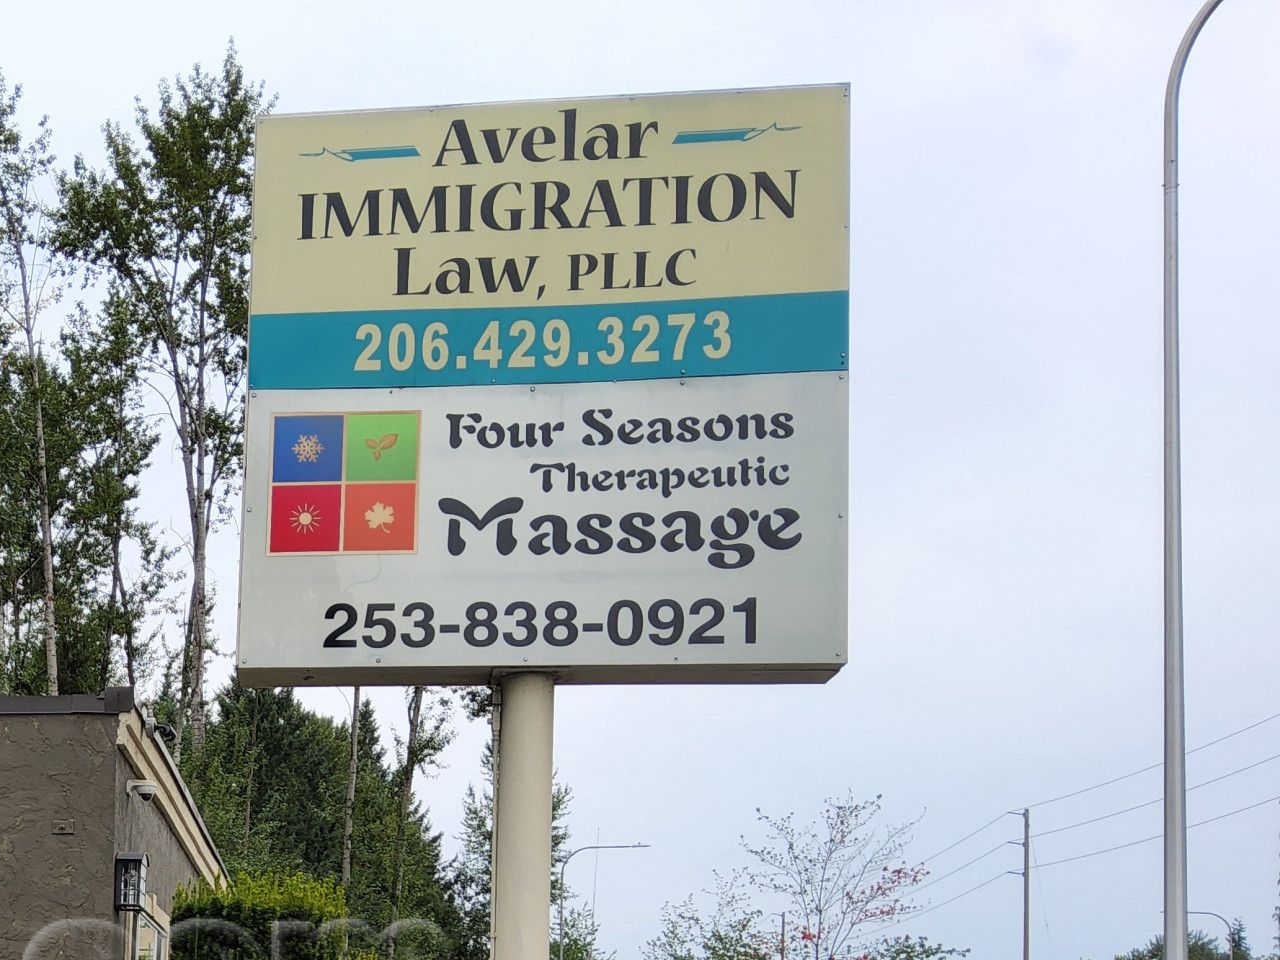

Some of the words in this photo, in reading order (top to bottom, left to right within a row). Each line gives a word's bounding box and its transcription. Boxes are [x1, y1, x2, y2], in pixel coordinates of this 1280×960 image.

[432, 108, 658, 167] Avelar
[297, 169, 801, 240] IMMIGRATION
[392, 248, 545, 300] Law,
[568, 249, 696, 291] PLLC
[353, 310, 732, 372] 206.429.3273
[446, 413, 564, 449] Four
[582, 409, 794, 446] Seasons
[530, 456, 790, 498] Therapeutic
[438, 497, 802, 569] Massage
[323, 597, 756, 648] 253-838-0921
